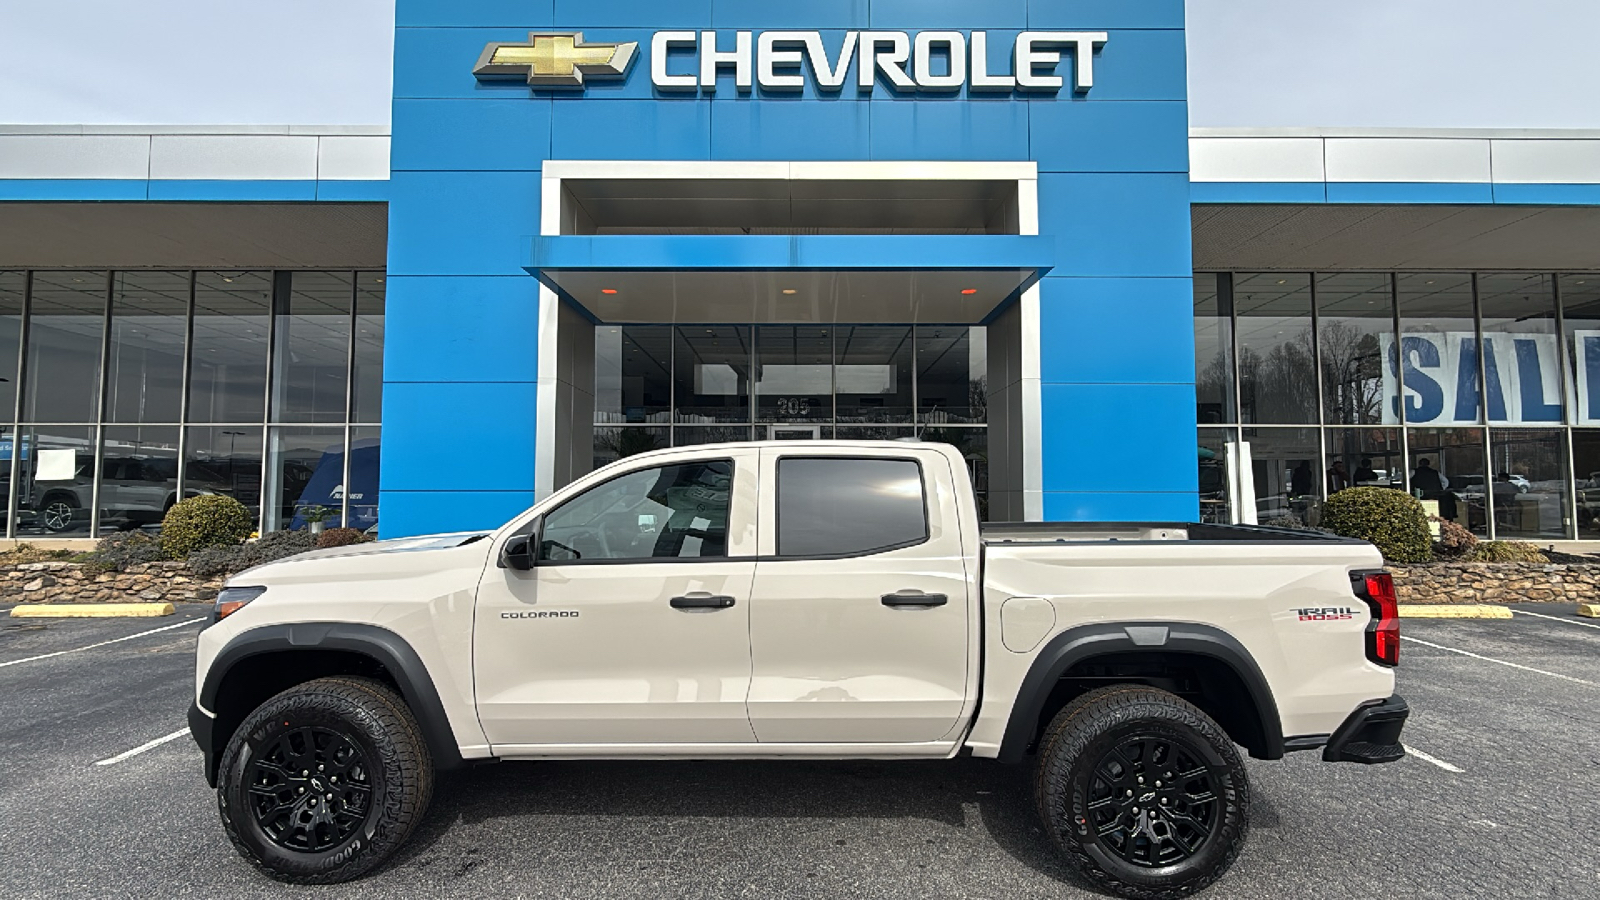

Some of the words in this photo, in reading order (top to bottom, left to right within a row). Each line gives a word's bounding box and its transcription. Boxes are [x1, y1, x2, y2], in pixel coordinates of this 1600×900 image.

[650, 29, 1109, 94] CHEVROLET
[777, 397, 811, 415] 205
[501, 611, 579, 619] COLORADO
[1289, 606, 1361, 616] TRAIL
[1298, 613, 1353, 622] BOSS
